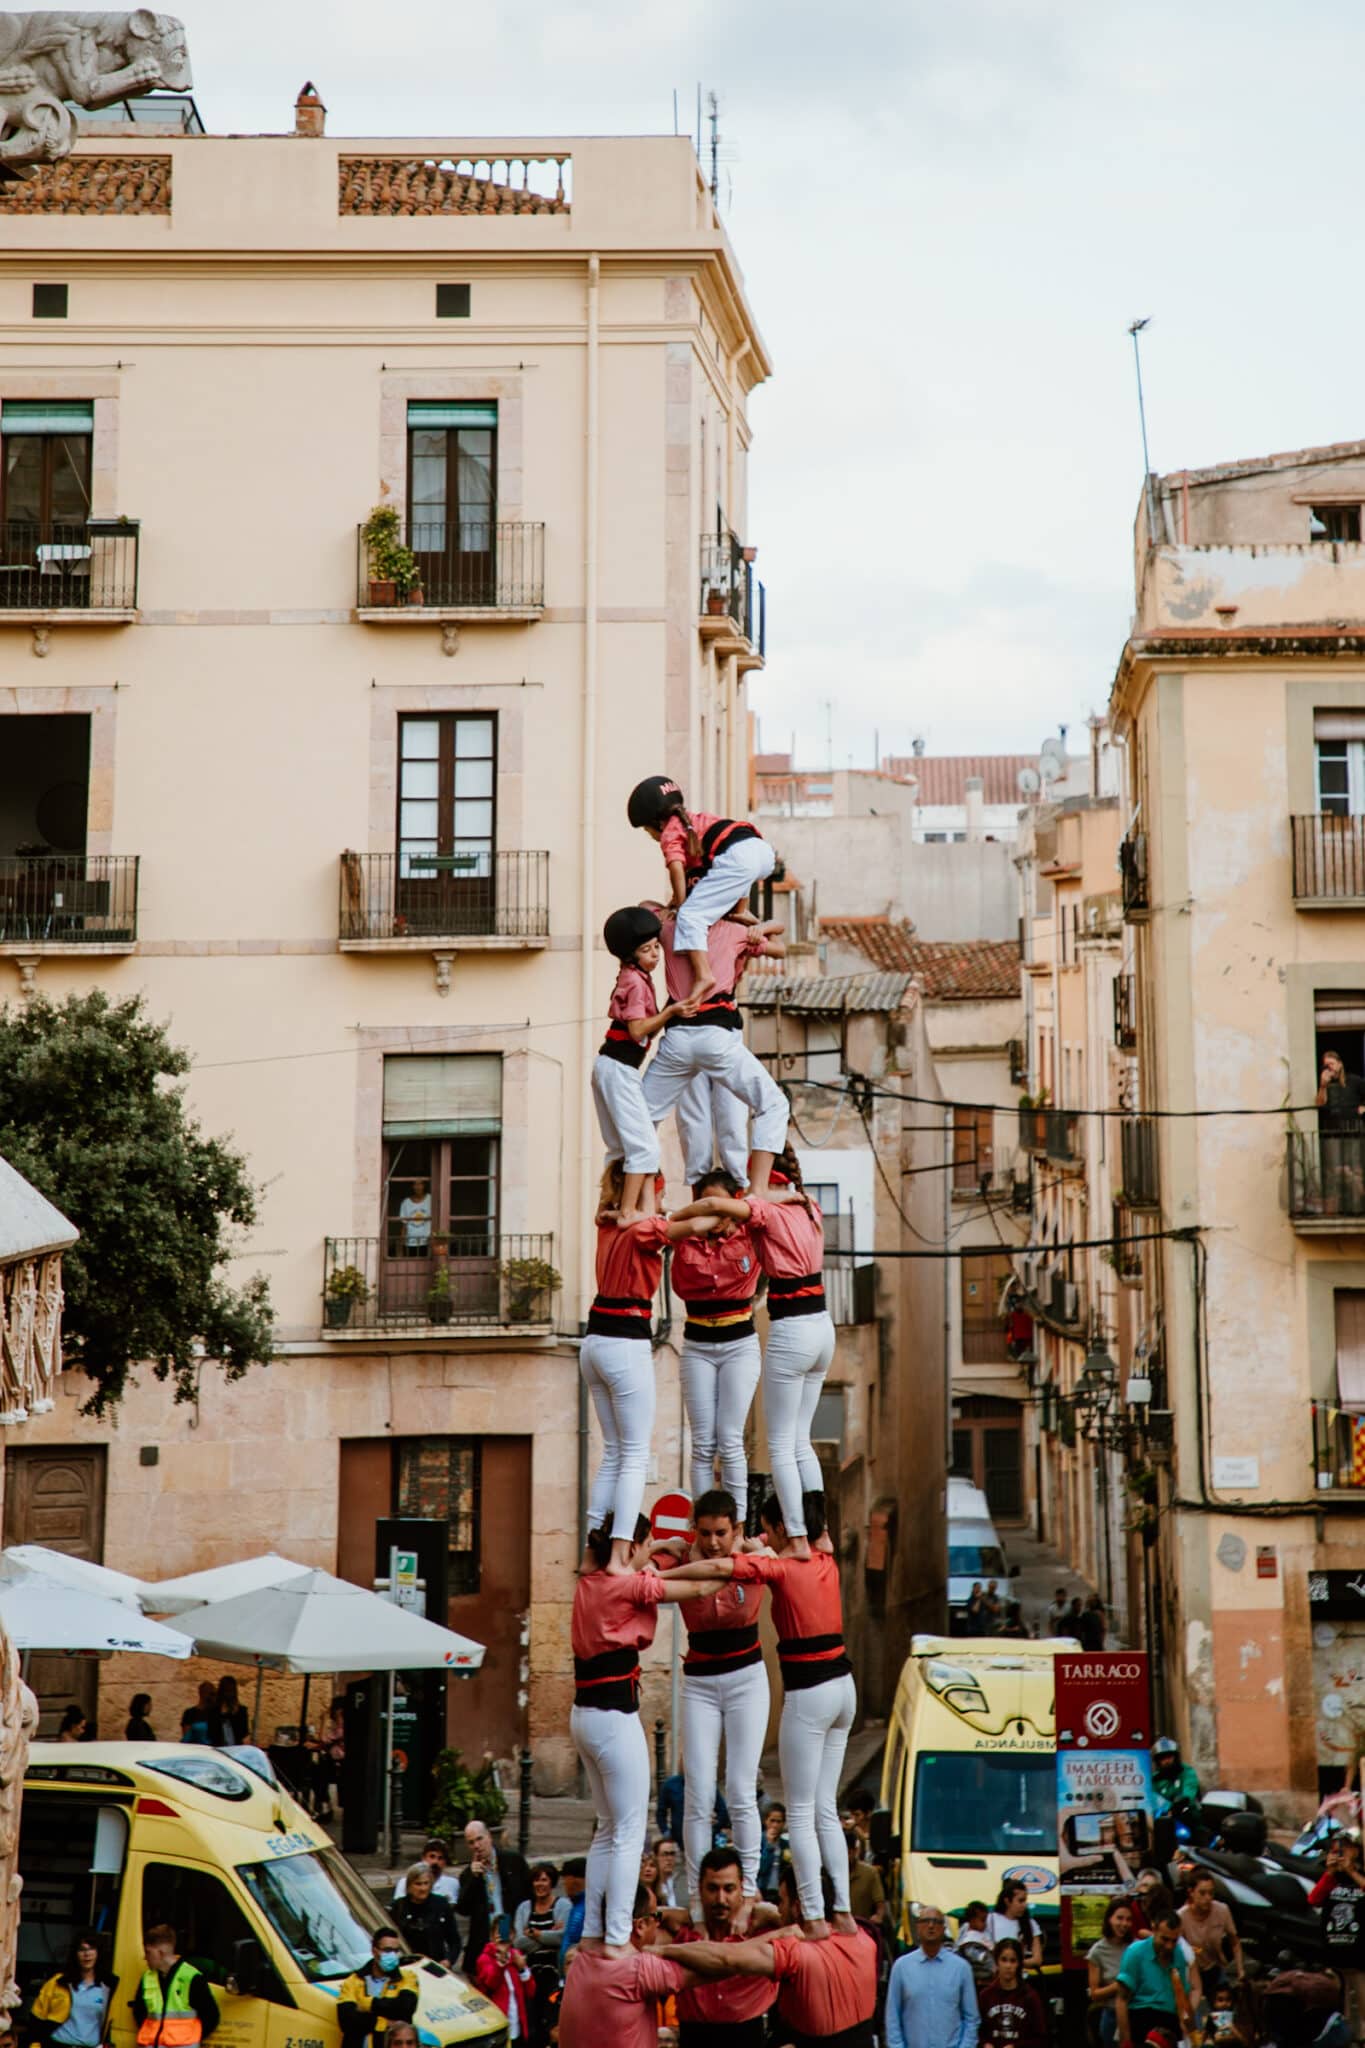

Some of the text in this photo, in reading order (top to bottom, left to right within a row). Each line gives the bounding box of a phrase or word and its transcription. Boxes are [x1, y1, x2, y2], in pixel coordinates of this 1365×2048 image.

[1061, 1663, 1141, 1679] TARRACO
[1066, 1761, 1135, 1775] IMAGEEN
[1076, 1774, 1145, 1786] TARRACO
